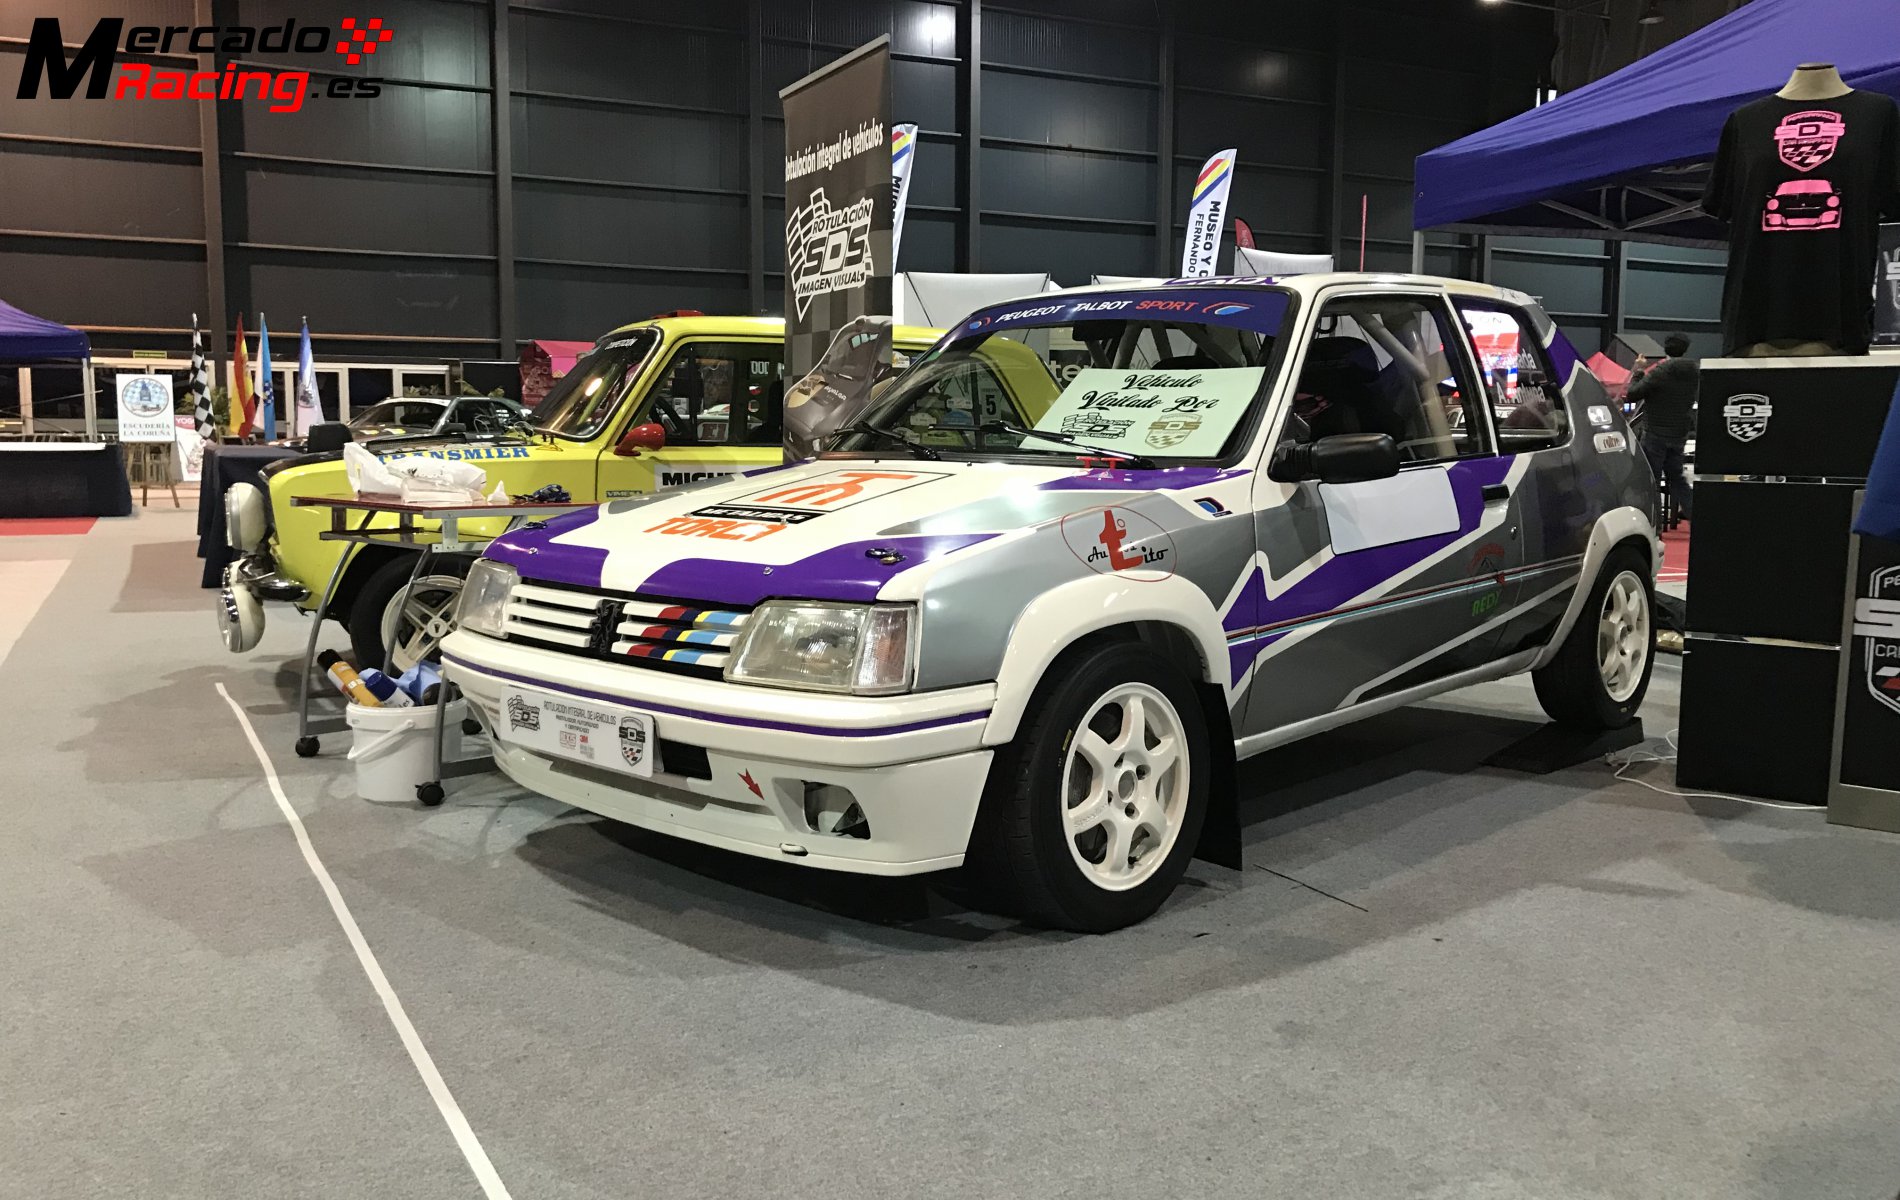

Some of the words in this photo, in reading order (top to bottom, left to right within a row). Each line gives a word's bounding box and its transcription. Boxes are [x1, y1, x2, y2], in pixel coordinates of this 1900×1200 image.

[816, 132, 842, 171] integral
[842, 129, 852, 159] de
[853, 118, 883, 156] vehículos
[812, 202, 871, 234] ROTULACIÓN
[1203, 200, 1222, 251] MUSEO
[802, 224, 868, 277] SDS
[1188, 213, 1205, 274] FERNANDO
[798, 277, 832, 295] IMAGEN
[995, 304, 1066, 324] PEUGEOT
[1072, 300, 1134, 313] TALBOT
[1135, 299, 1200, 312] SPORT
[985, 394, 997, 416] 5
[1077, 389, 1164, 411] Vinilado
[1161, 395, 1220, 413] Por
[579, 735, 589, 743] 3M
[618, 726, 646, 743] SDS
